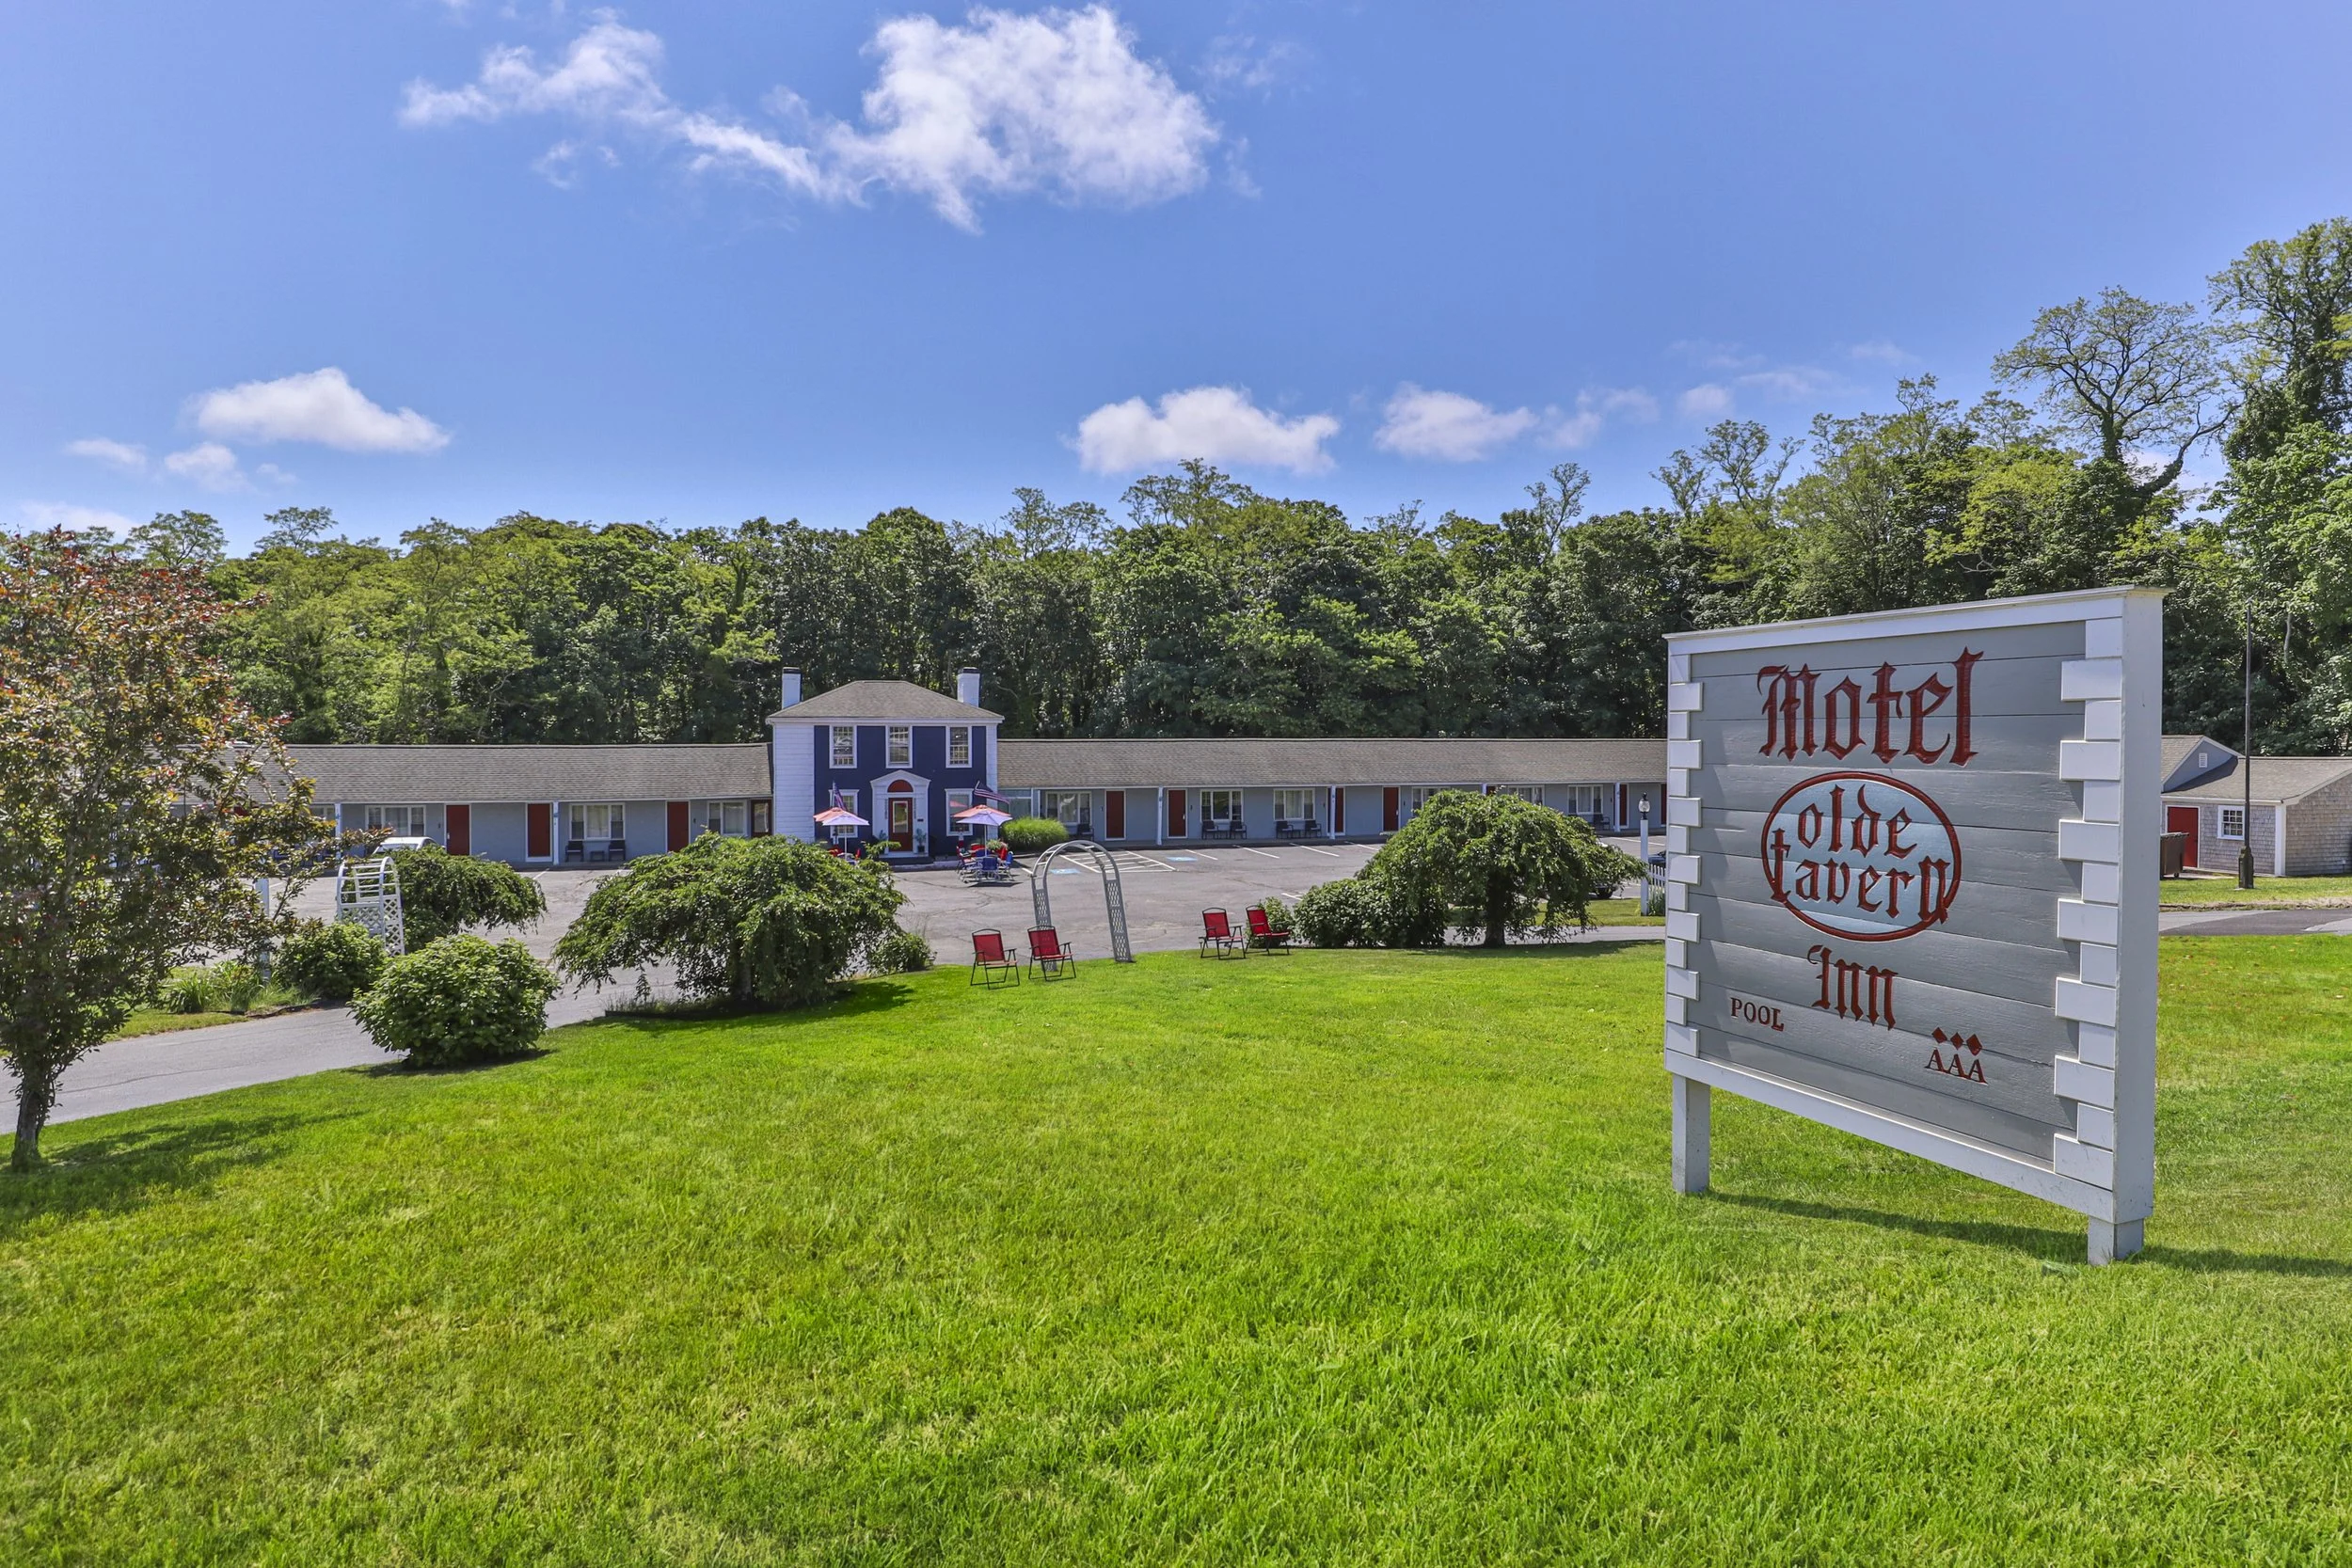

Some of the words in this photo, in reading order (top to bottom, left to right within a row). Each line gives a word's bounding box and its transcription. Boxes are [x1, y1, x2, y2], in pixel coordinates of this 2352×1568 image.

[1757, 646, 1985, 768] Motel
[1730, 997, 1785, 1032] POOL
[1807, 944, 1899, 1031] Inn
[1924, 1048, 1988, 1085] AAA
